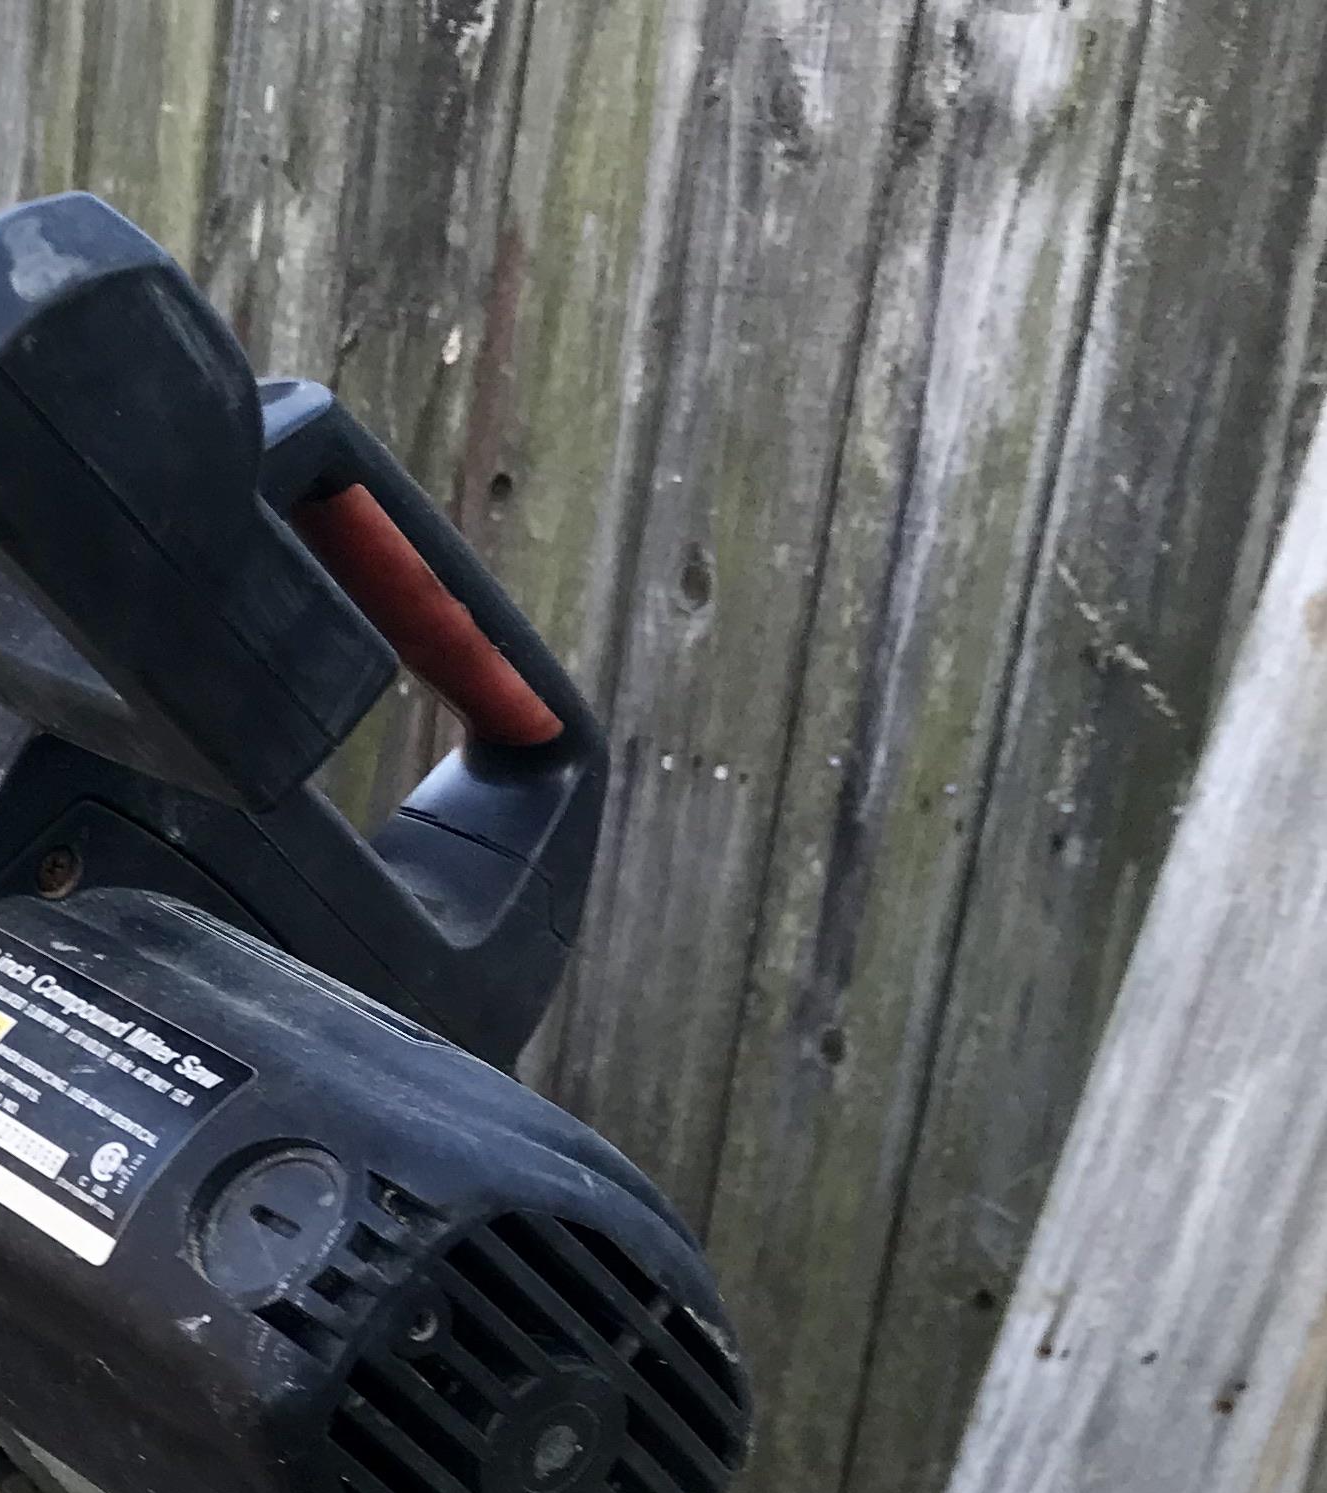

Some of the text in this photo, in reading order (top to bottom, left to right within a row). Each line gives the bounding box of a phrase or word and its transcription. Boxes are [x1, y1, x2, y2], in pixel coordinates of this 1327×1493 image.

[29, 971, 136, 1039] Compound
[122, 1024, 182, 1065] Miter
[171, 1054, 225, 1090] Saw
